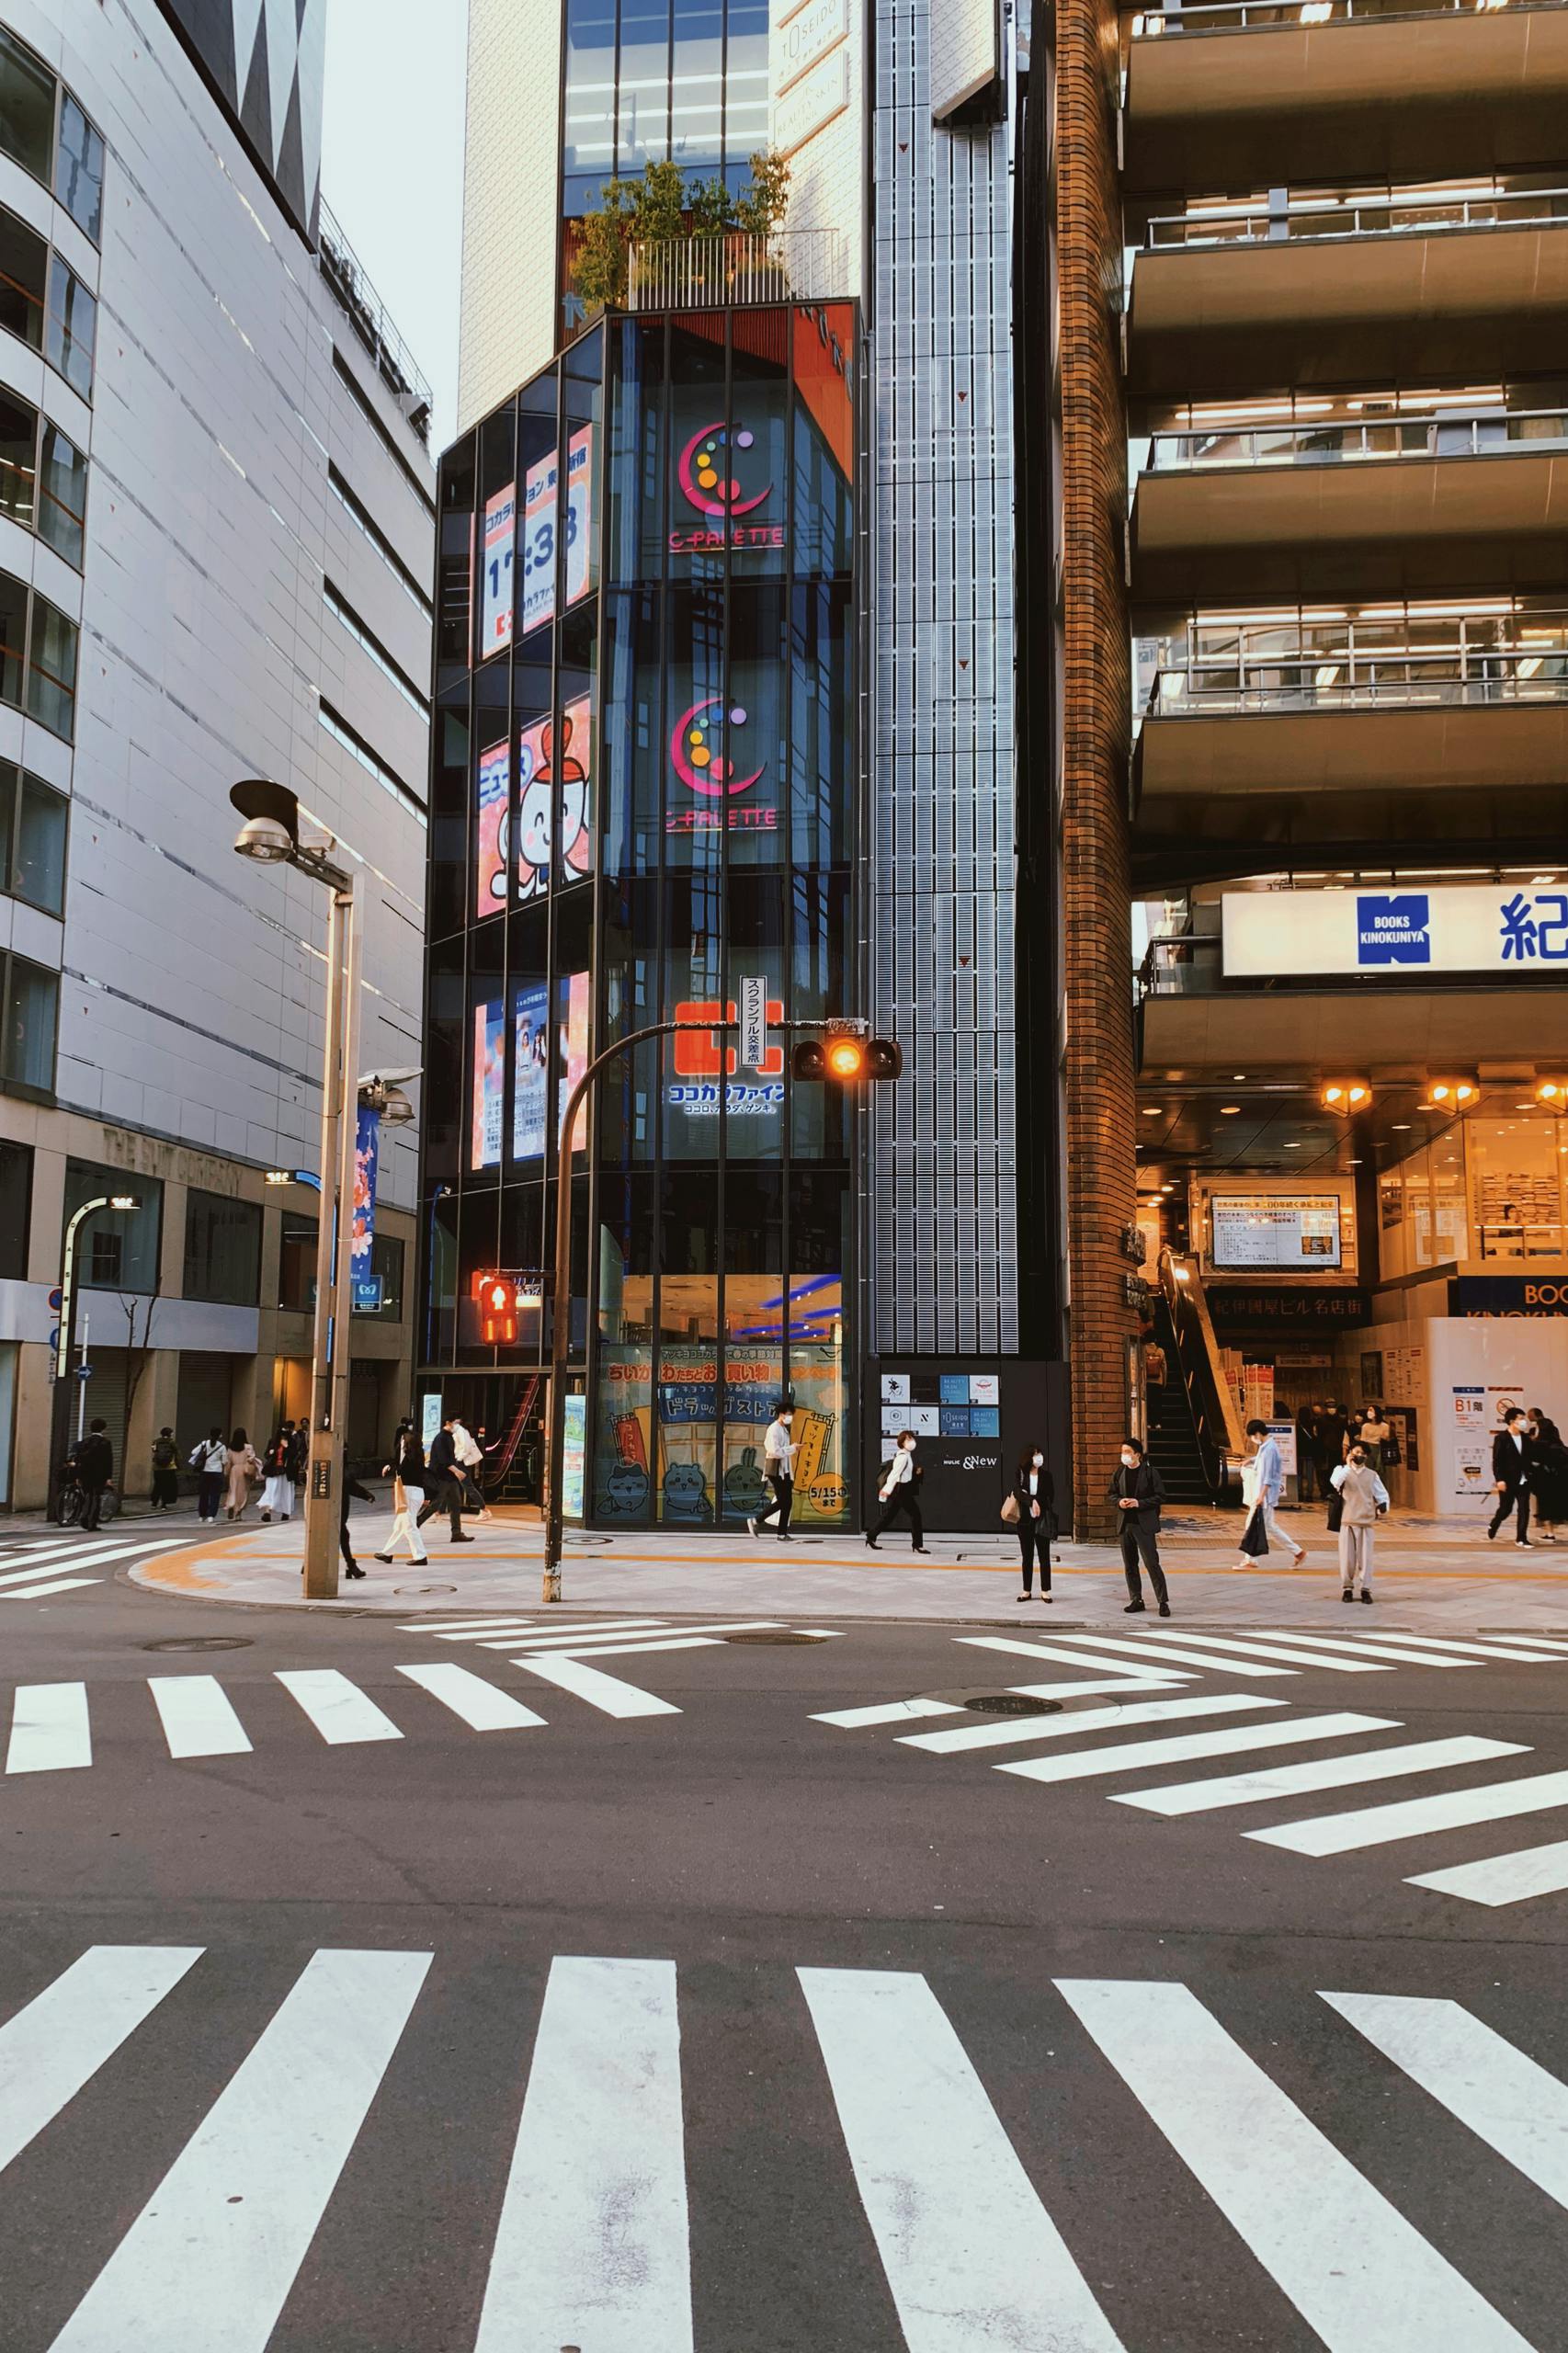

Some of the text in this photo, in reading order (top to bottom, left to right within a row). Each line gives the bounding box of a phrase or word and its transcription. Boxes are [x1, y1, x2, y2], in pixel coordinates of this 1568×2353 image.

[1374, 916, 1410, 928] BOOKS
[1360, 931, 1425, 944] KINOKUNIYA
[747, 979, 760, 1063] スクランブル交差点
[670, 1085, 784, 1102] ココカラファイン
